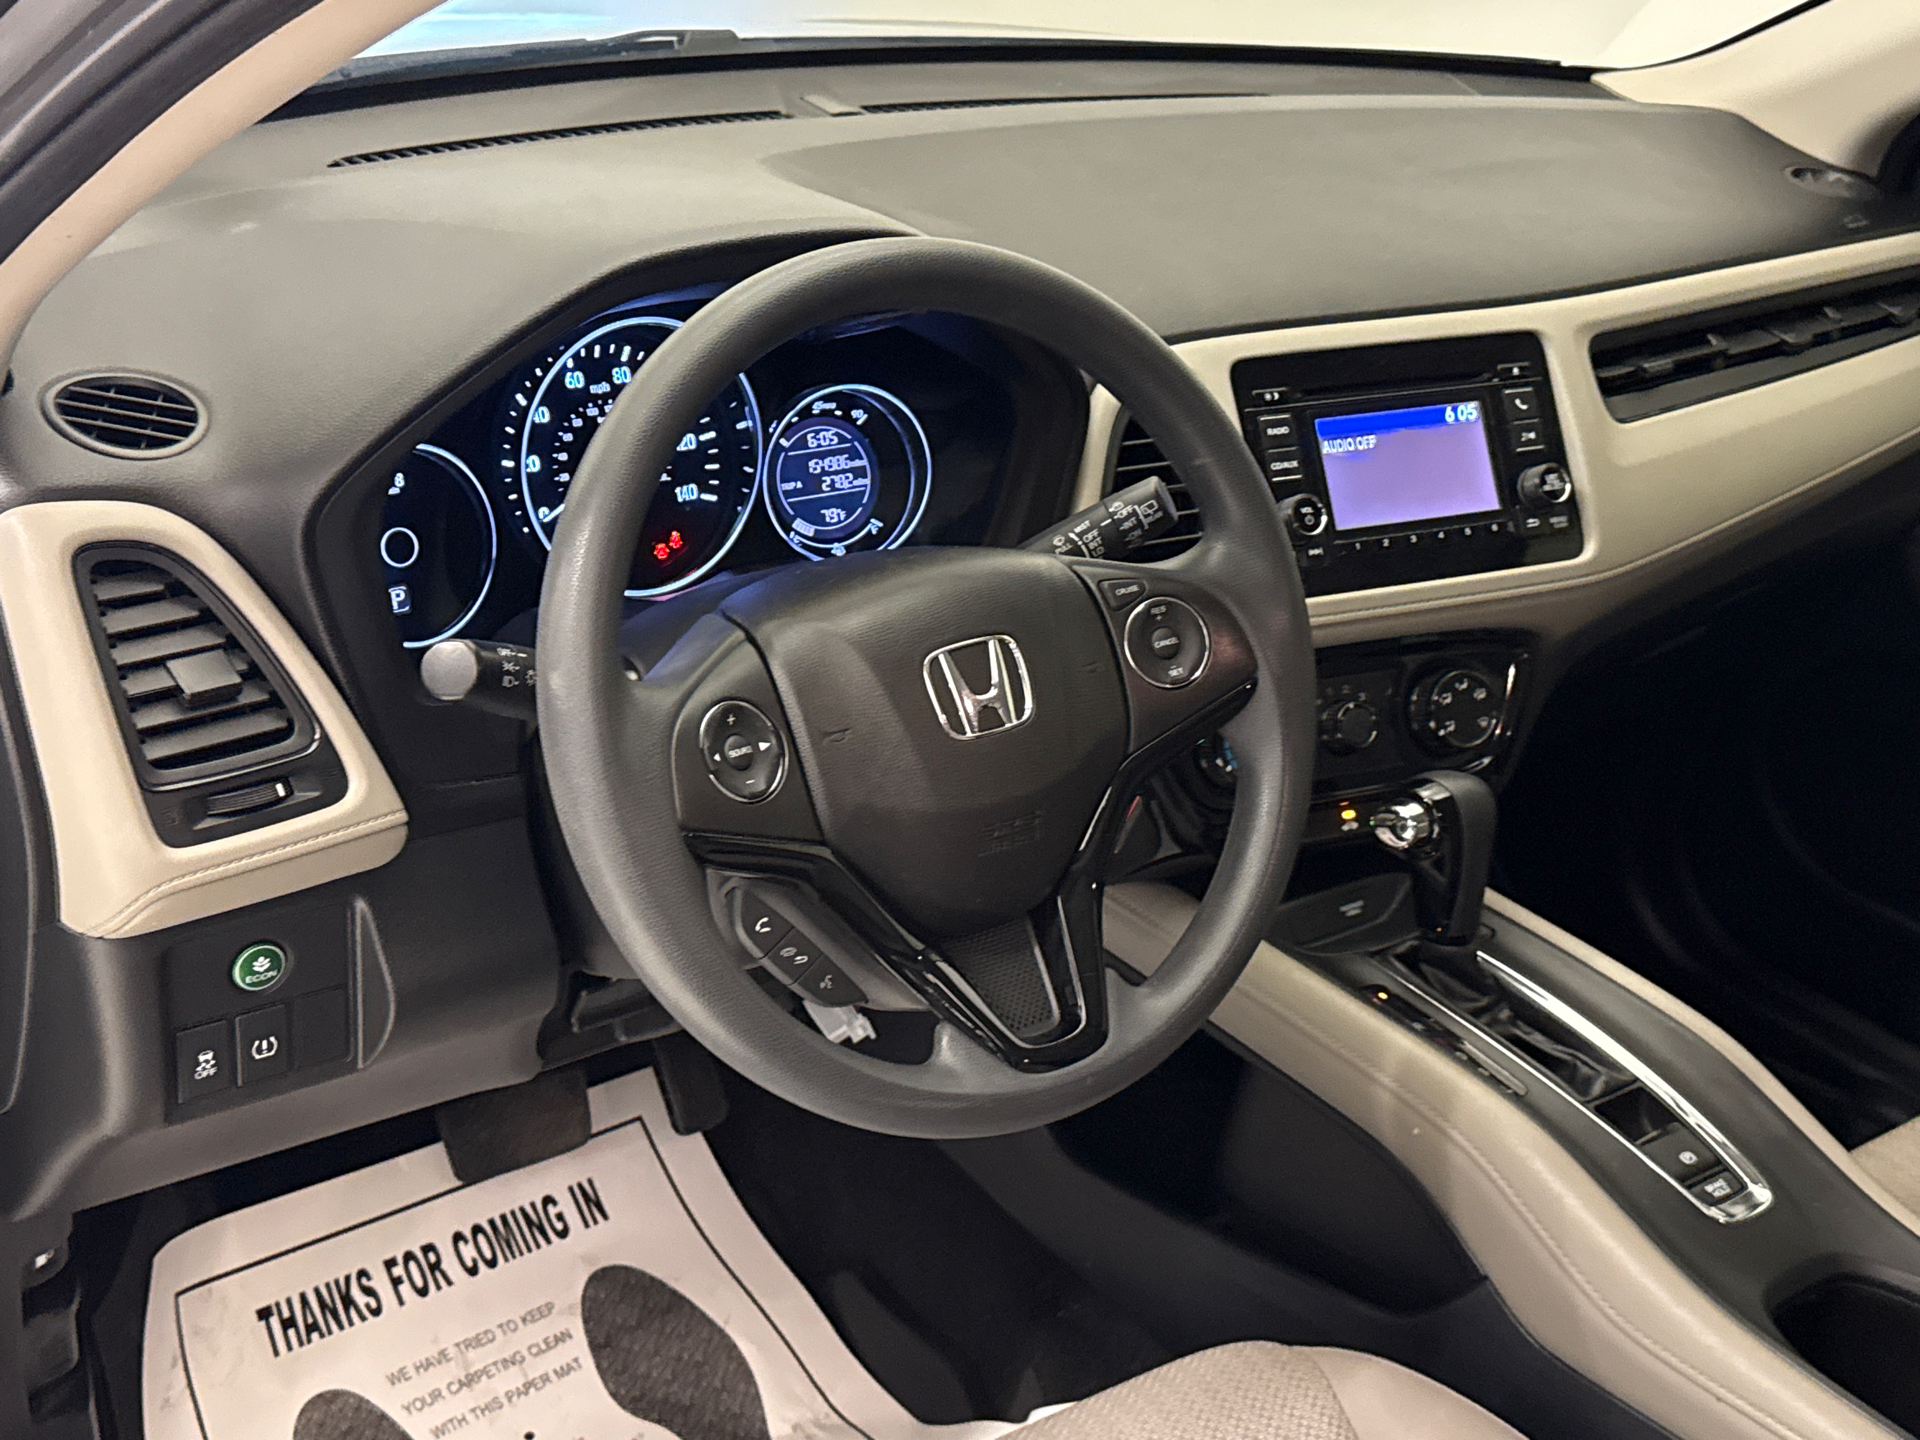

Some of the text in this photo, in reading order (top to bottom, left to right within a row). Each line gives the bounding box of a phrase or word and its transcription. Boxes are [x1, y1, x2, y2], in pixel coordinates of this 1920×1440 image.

[565, 371, 585, 389] 60
[612, 366, 632, 384] 80
[677, 433, 697, 451] 20
[807, 431, 839, 448] 6:05
[1322, 434, 1377, 454] AUDIO OFF
[394, 472, 405, 487] 8
[674, 483, 698, 502] 140
[1082, 529, 1100, 543] OFF
[1115, 585, 1140, 596] CRUISE
[1150, 605, 1166, 616] RES
[1154, 637, 1180, 648] CANCEL
[1168, 667, 1185, 677] SET
[245, 969, 278, 984] ECON
[194, 1066, 218, 1080] OFF
[256, 1178, 610, 1358] THANKS FOR COMING IN
[386, 1301, 555, 1386] WE HAVE TRIED TO KEEP
[401, 1328, 574, 1416] YOUR CARPETING CLEAN
[429, 1356, 583, 1440] WITH THIS PAPER MAT
